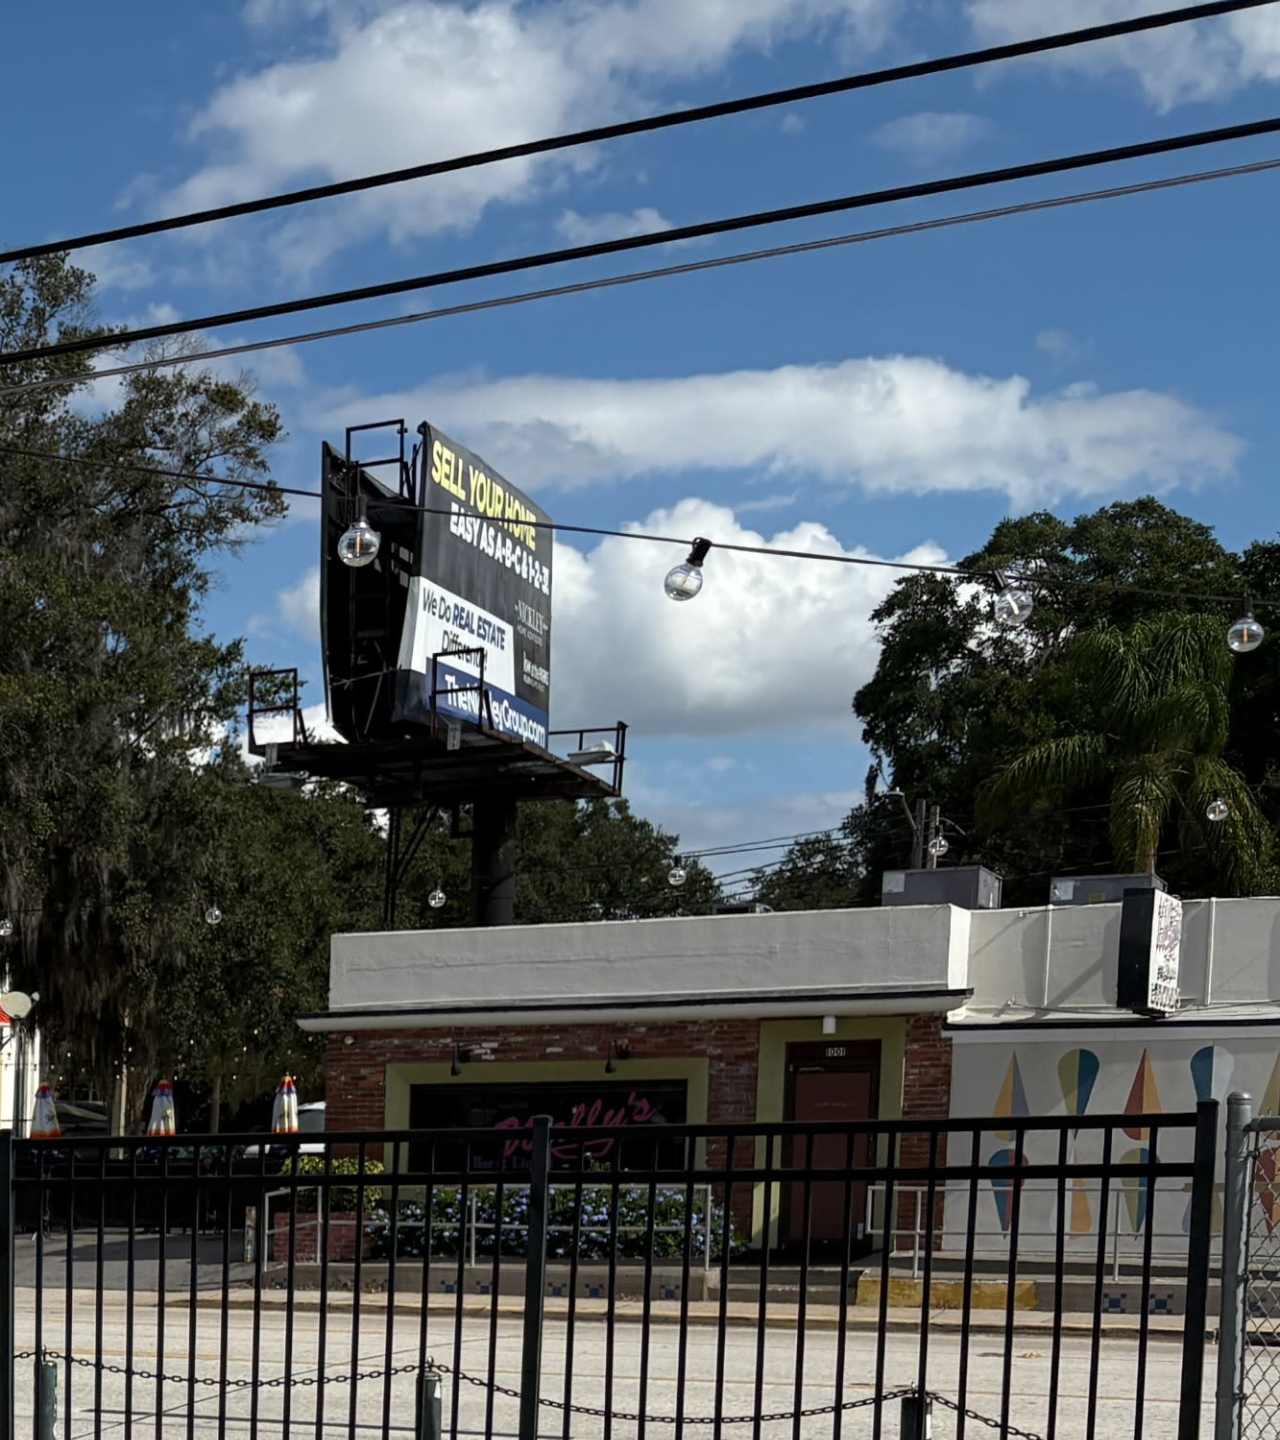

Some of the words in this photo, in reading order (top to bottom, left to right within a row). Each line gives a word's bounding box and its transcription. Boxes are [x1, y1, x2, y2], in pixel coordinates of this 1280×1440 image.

[431, 440, 466, 500] SELL
[469, 464, 503, 526] YOUR
[504, 491, 537, 552] HOME
[450, 502, 481, 547] EASY
[480, 522, 495, 557] AS
[423, 587, 437, 616] We
[440, 596, 451, 623] Do
[452, 603, 476, 637] REAL
[477, 615, 506, 650] ESTATE
